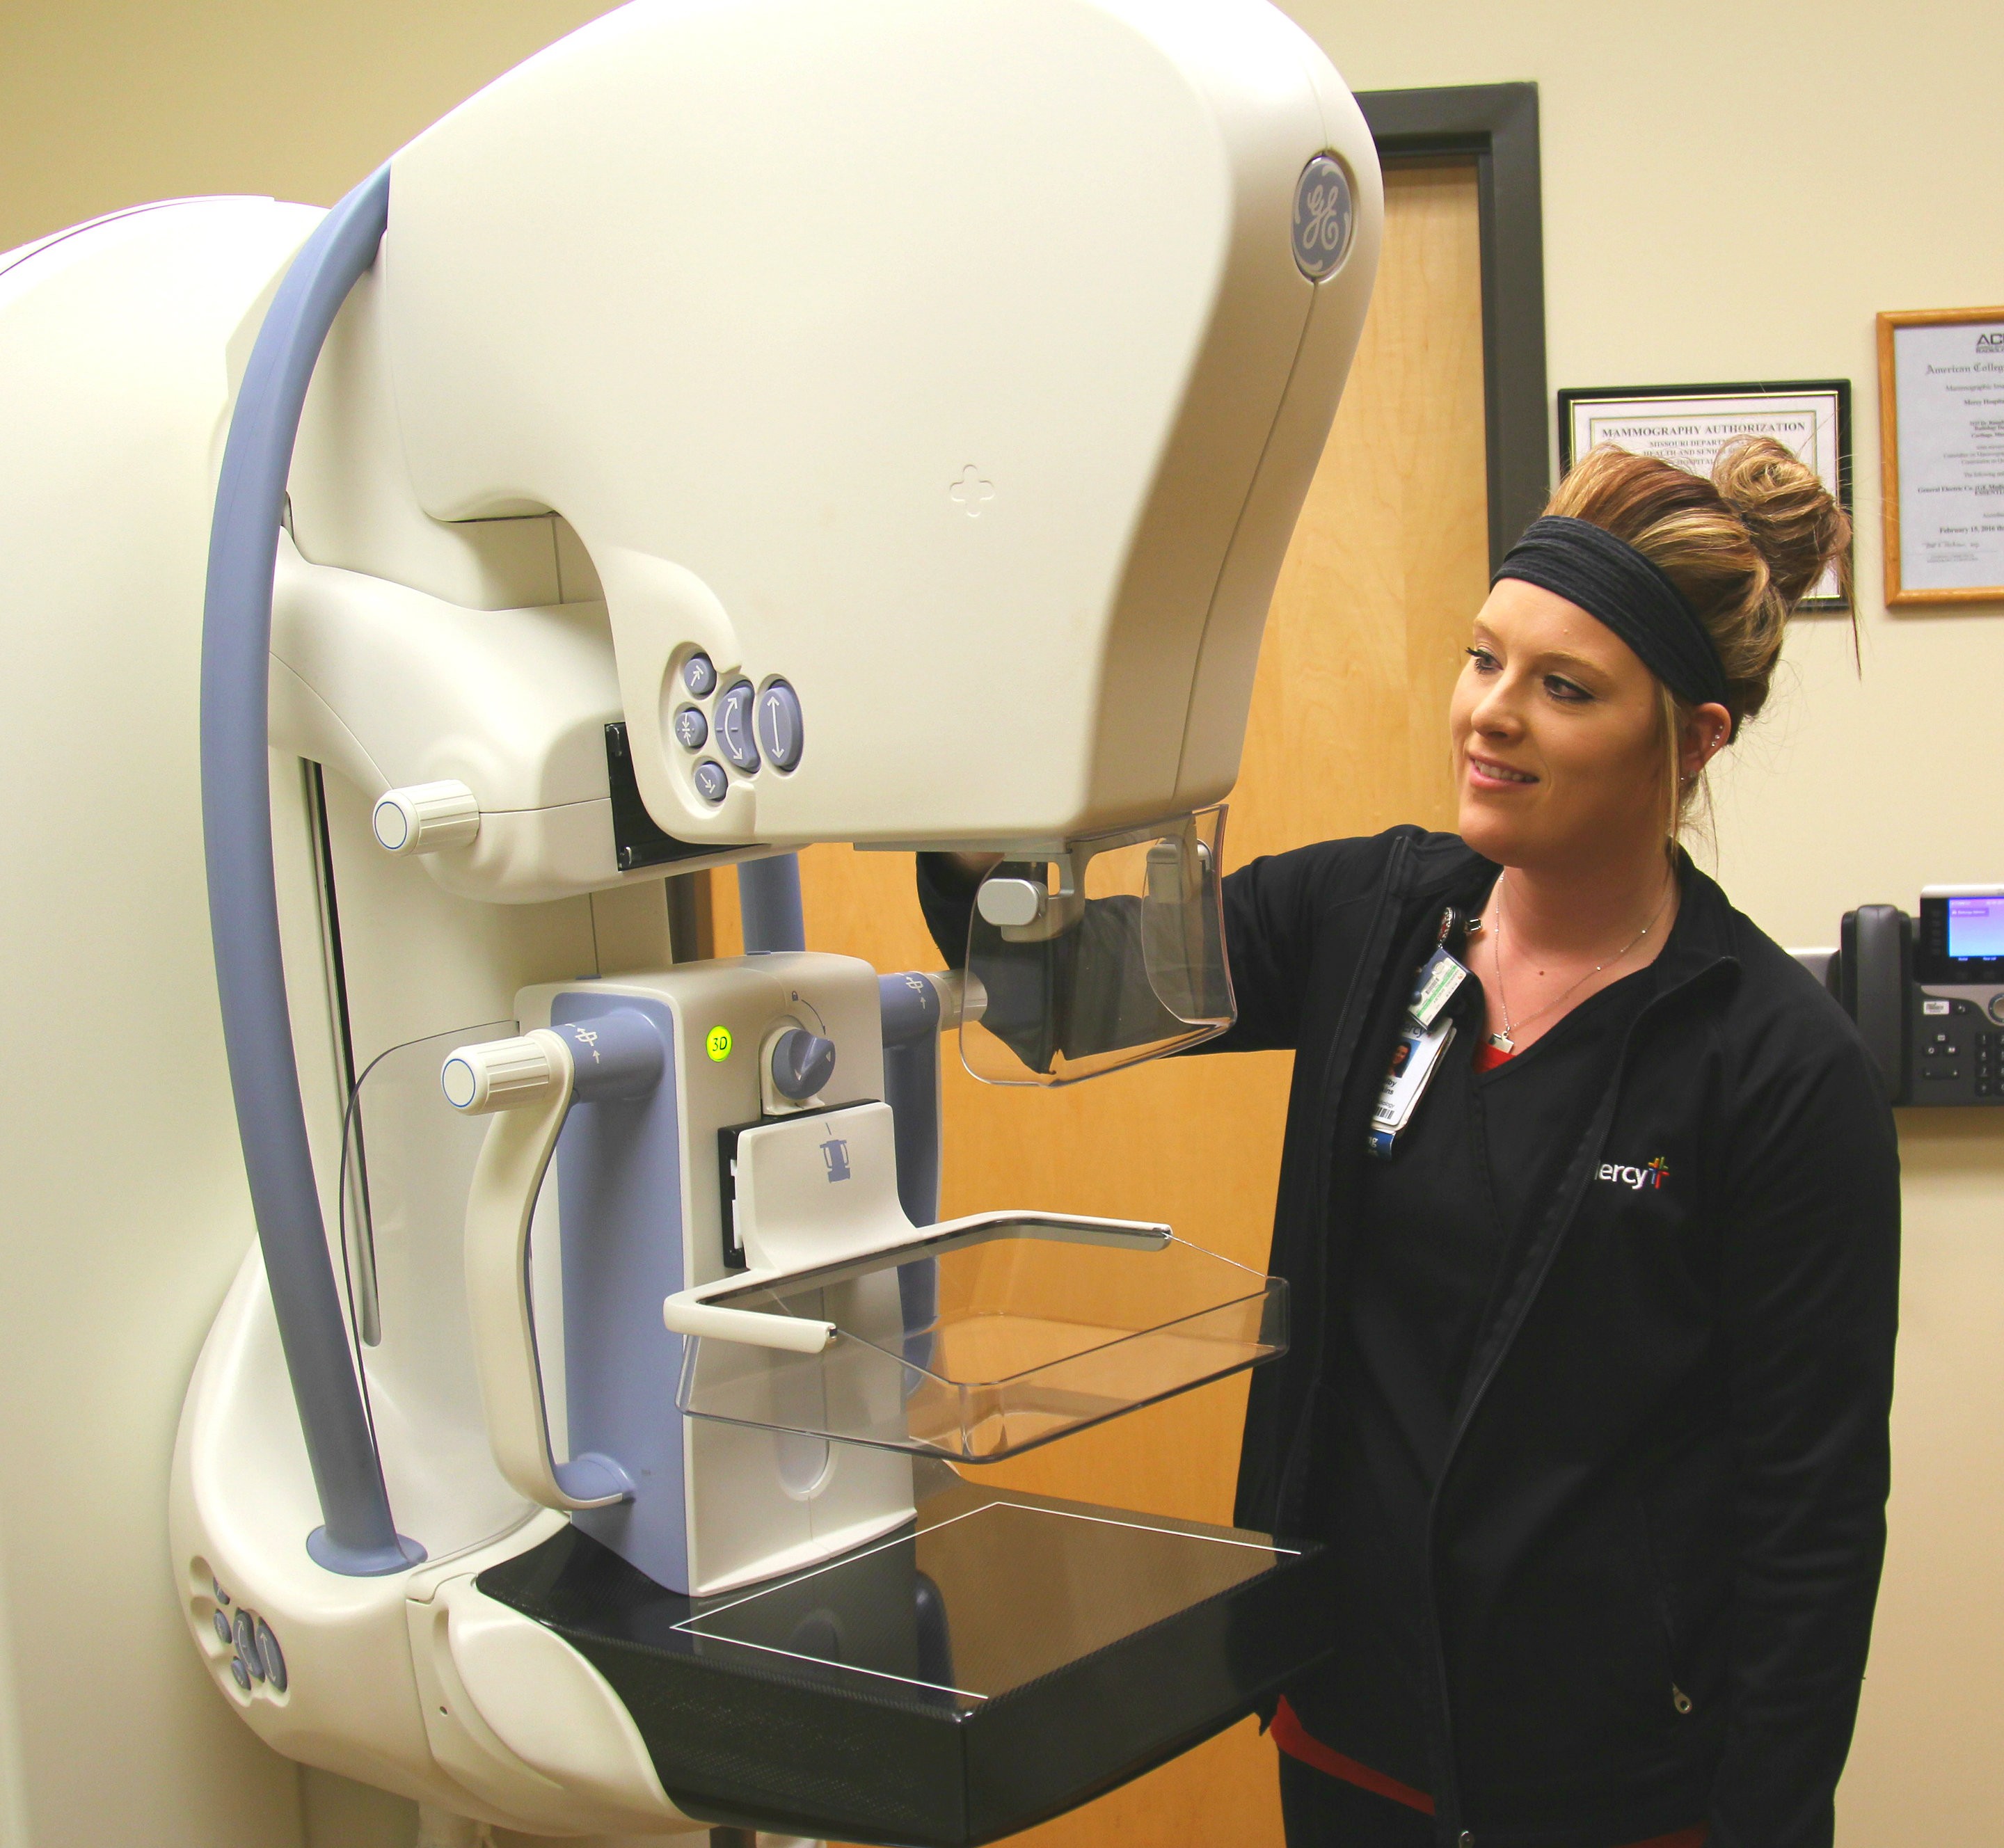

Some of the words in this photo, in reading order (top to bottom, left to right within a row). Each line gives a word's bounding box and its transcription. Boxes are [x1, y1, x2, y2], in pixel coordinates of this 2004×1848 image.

[1926, 364, 1971, 375] American
[1973, 362, 2004, 374] Colleg
[1603, 425, 1701, 438] MAMMOGRAPHY
[1705, 422, 1806, 434] AUTHORIZATION
[712, 1036, 728, 1051] 3D
[1595, 1163, 1648, 1190] ercy
